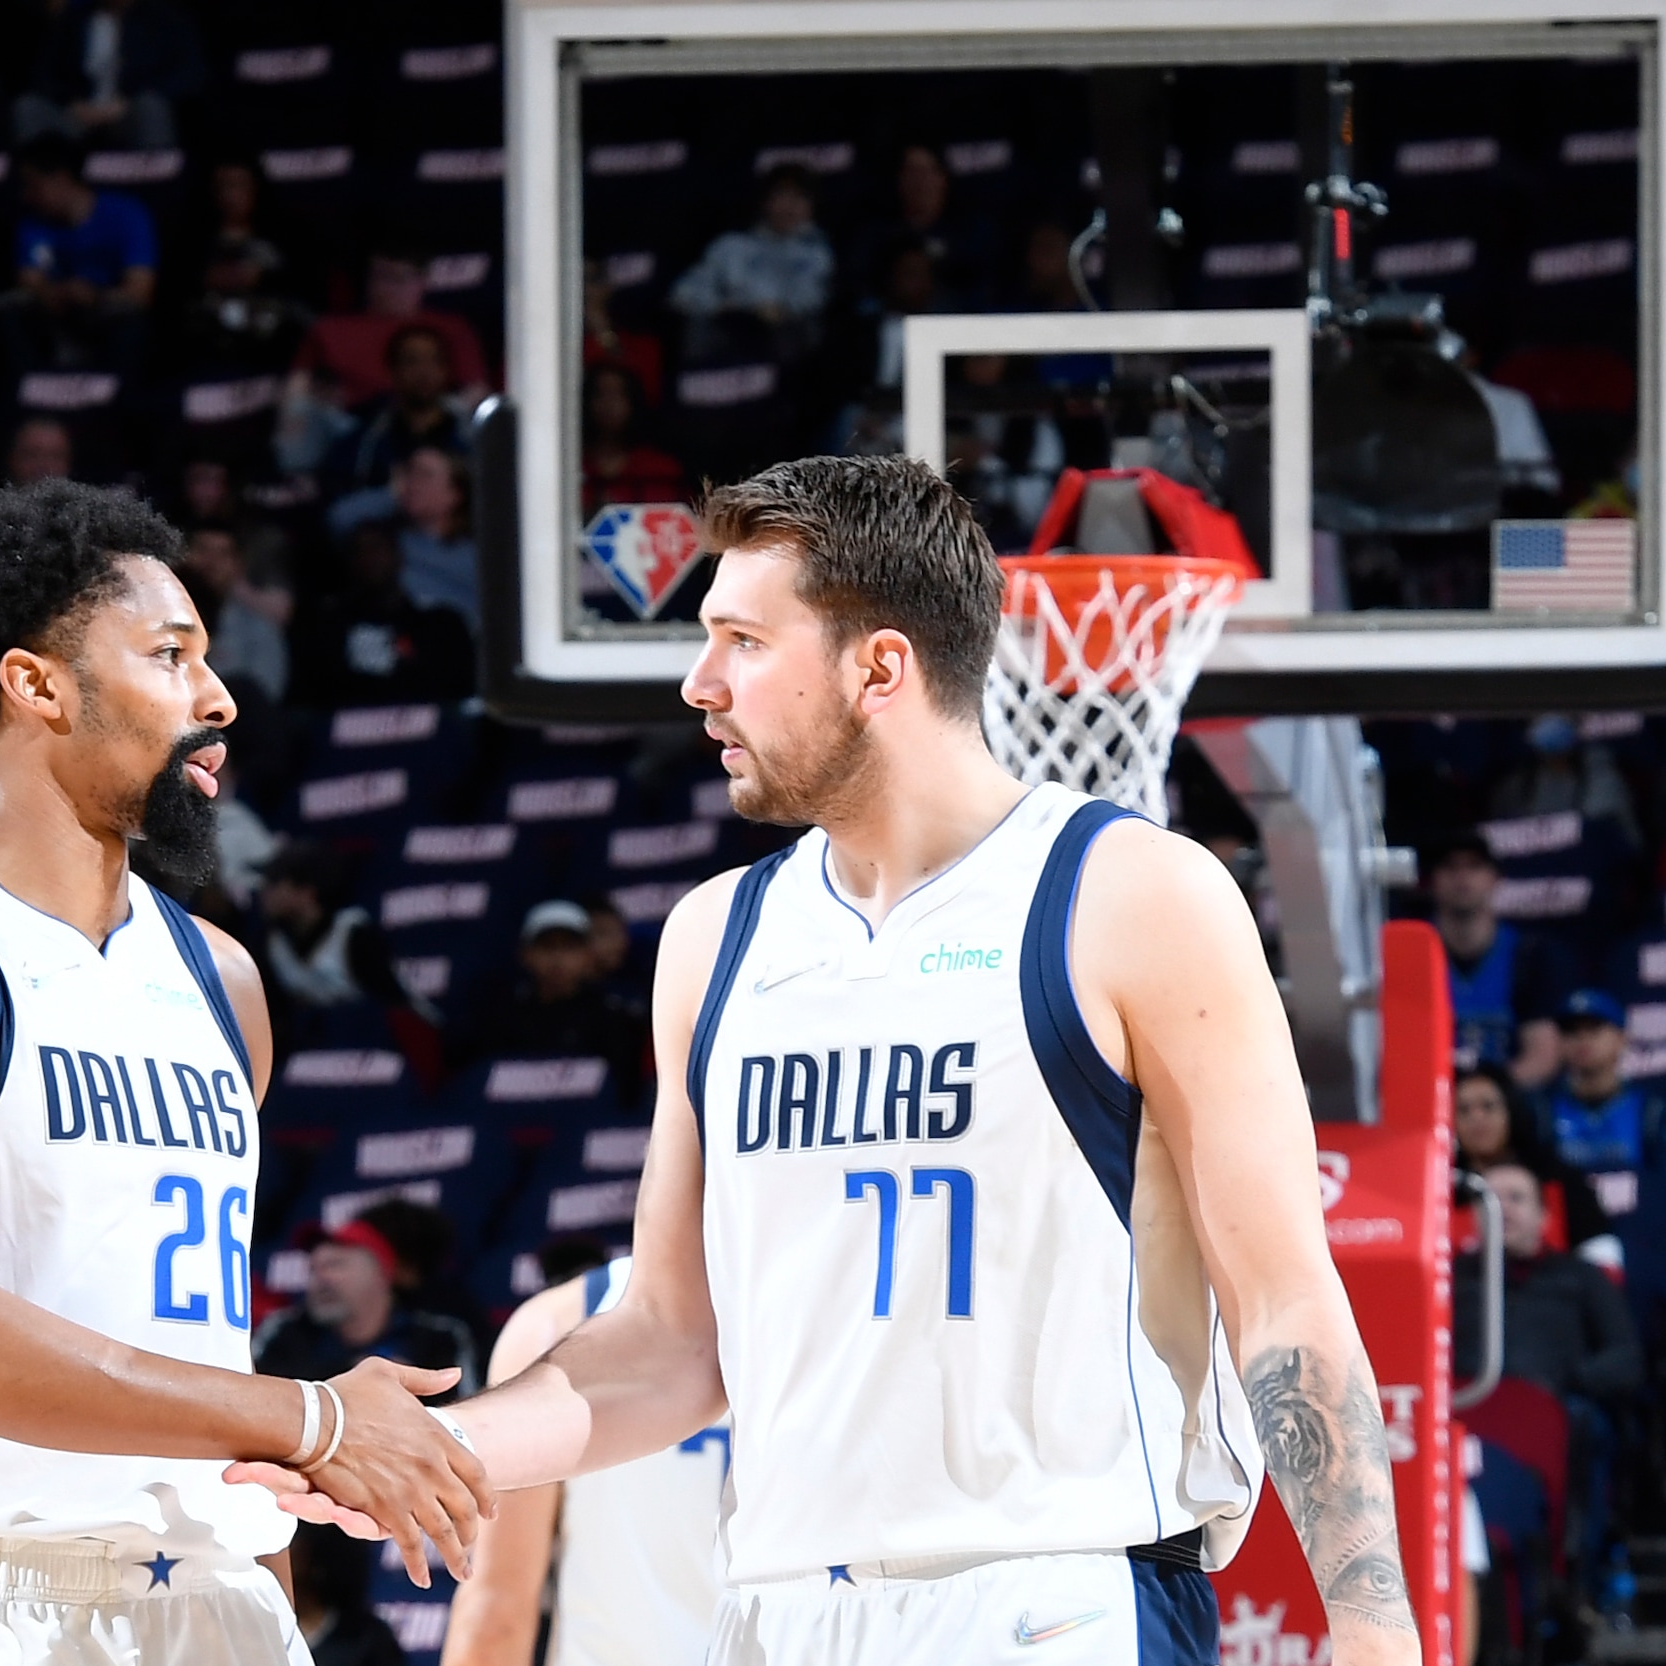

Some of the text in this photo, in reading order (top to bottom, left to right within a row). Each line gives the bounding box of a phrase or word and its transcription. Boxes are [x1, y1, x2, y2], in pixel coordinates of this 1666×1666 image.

[920, 942, 1002, 974] chime
[37, 1043, 248, 1159] DALLAS
[735, 1041, 979, 1158] DALLAS
[150, 1173, 250, 1331] 26
[843, 1165, 977, 1321] 77
